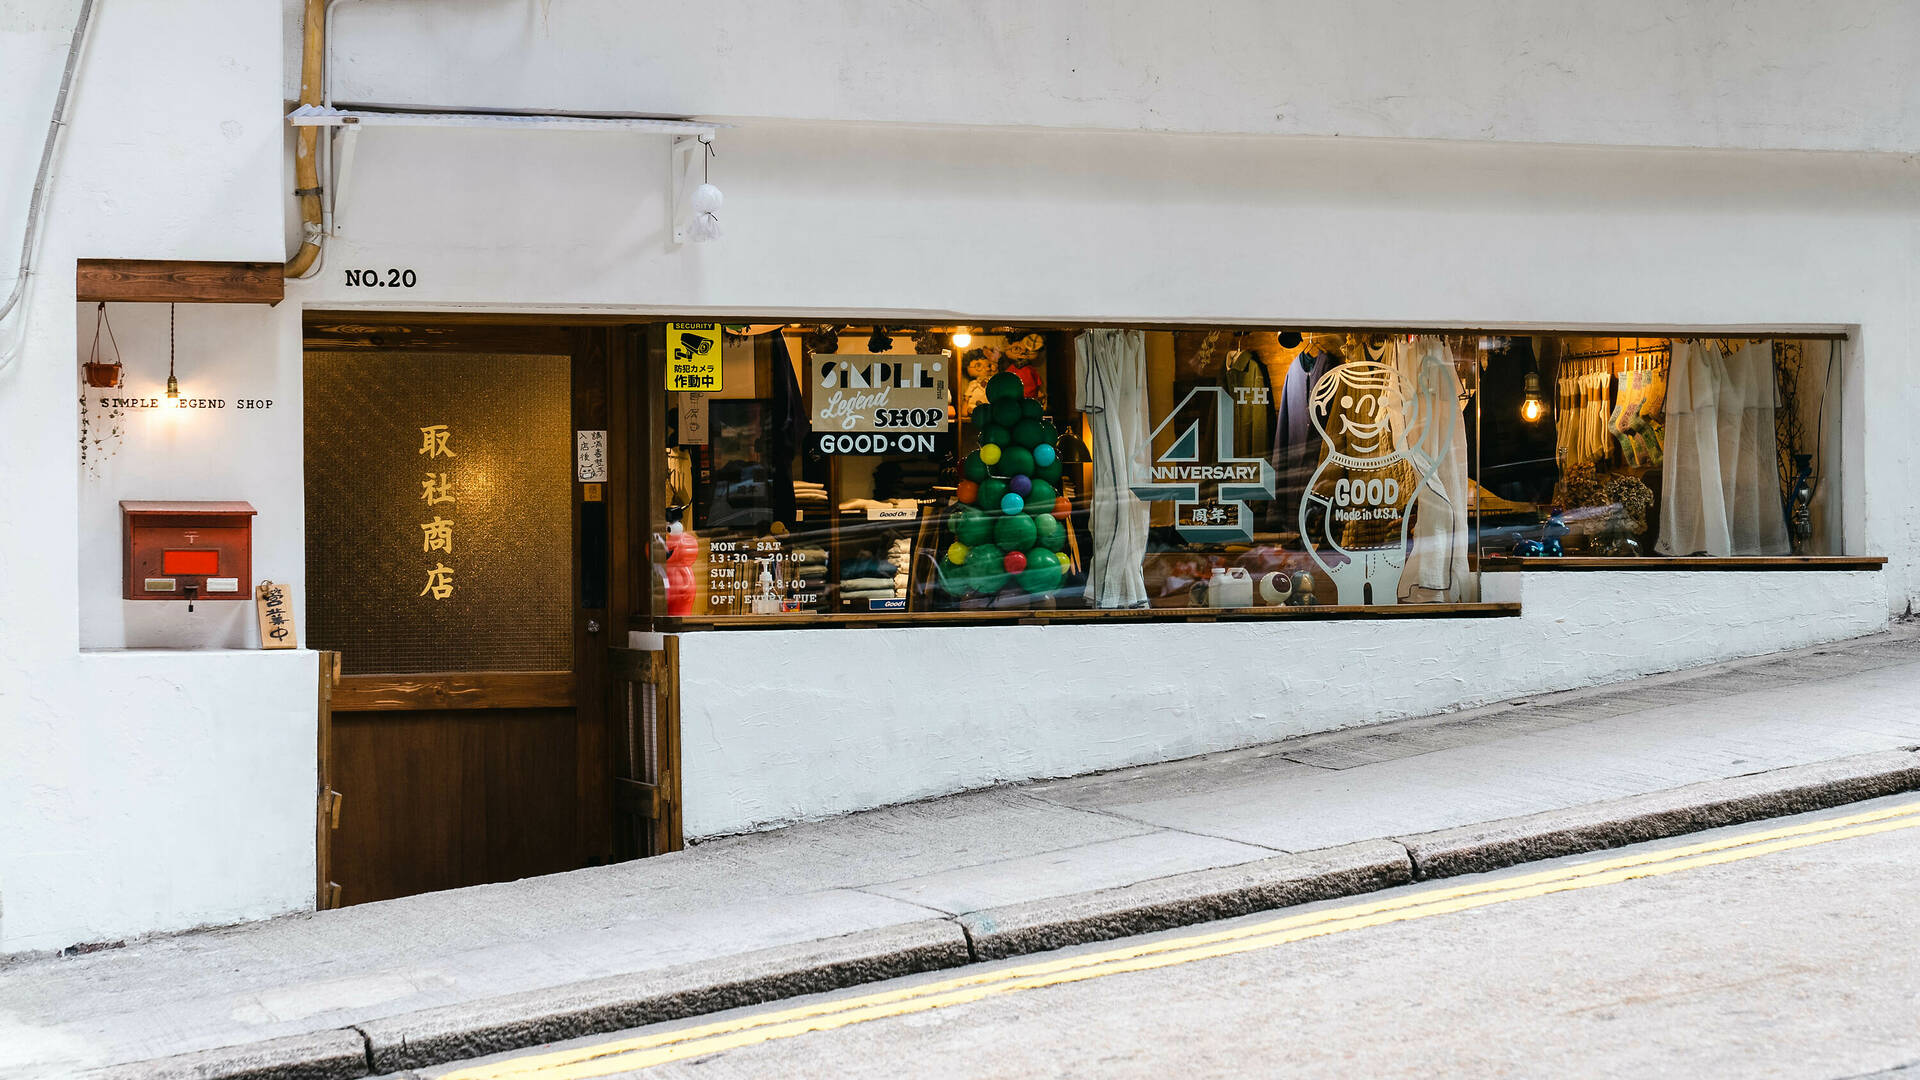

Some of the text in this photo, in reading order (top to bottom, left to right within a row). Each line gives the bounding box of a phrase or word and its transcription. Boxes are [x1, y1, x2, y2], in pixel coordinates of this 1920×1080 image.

[345, 269, 417, 288] NO.20
[675, 322, 713, 330] SECURITY
[674, 364, 714, 374] 防犯カメラ
[674, 374, 714, 388] 作動中
[101, 398, 274, 409] SIMPLE EGEND SHOP
[820, 386, 891, 430] Legend
[874, 407, 943, 428] SHOP
[1128, 386, 1276, 543] 4 TH
[1139, 466, 1258, 480] NNIVERSARY
[1335, 478, 1399, 507] GOOD
[419, 424, 457, 600] 取社商店
[1192, 508, 1227, 523] 周年
[1335, 507, 1402, 521] Made in U.S.A.
[710, 542, 737, 552] MON
[756, 542, 781, 551] SAT
[710, 553, 748, 563] 13:30
[768, 553, 806, 562] 20:00
[710, 568, 735, 578] SUN
[711, 580, 749, 590] 14:00
[711, 595, 736, 605] OFF
[793, 594, 817, 603] TUE
